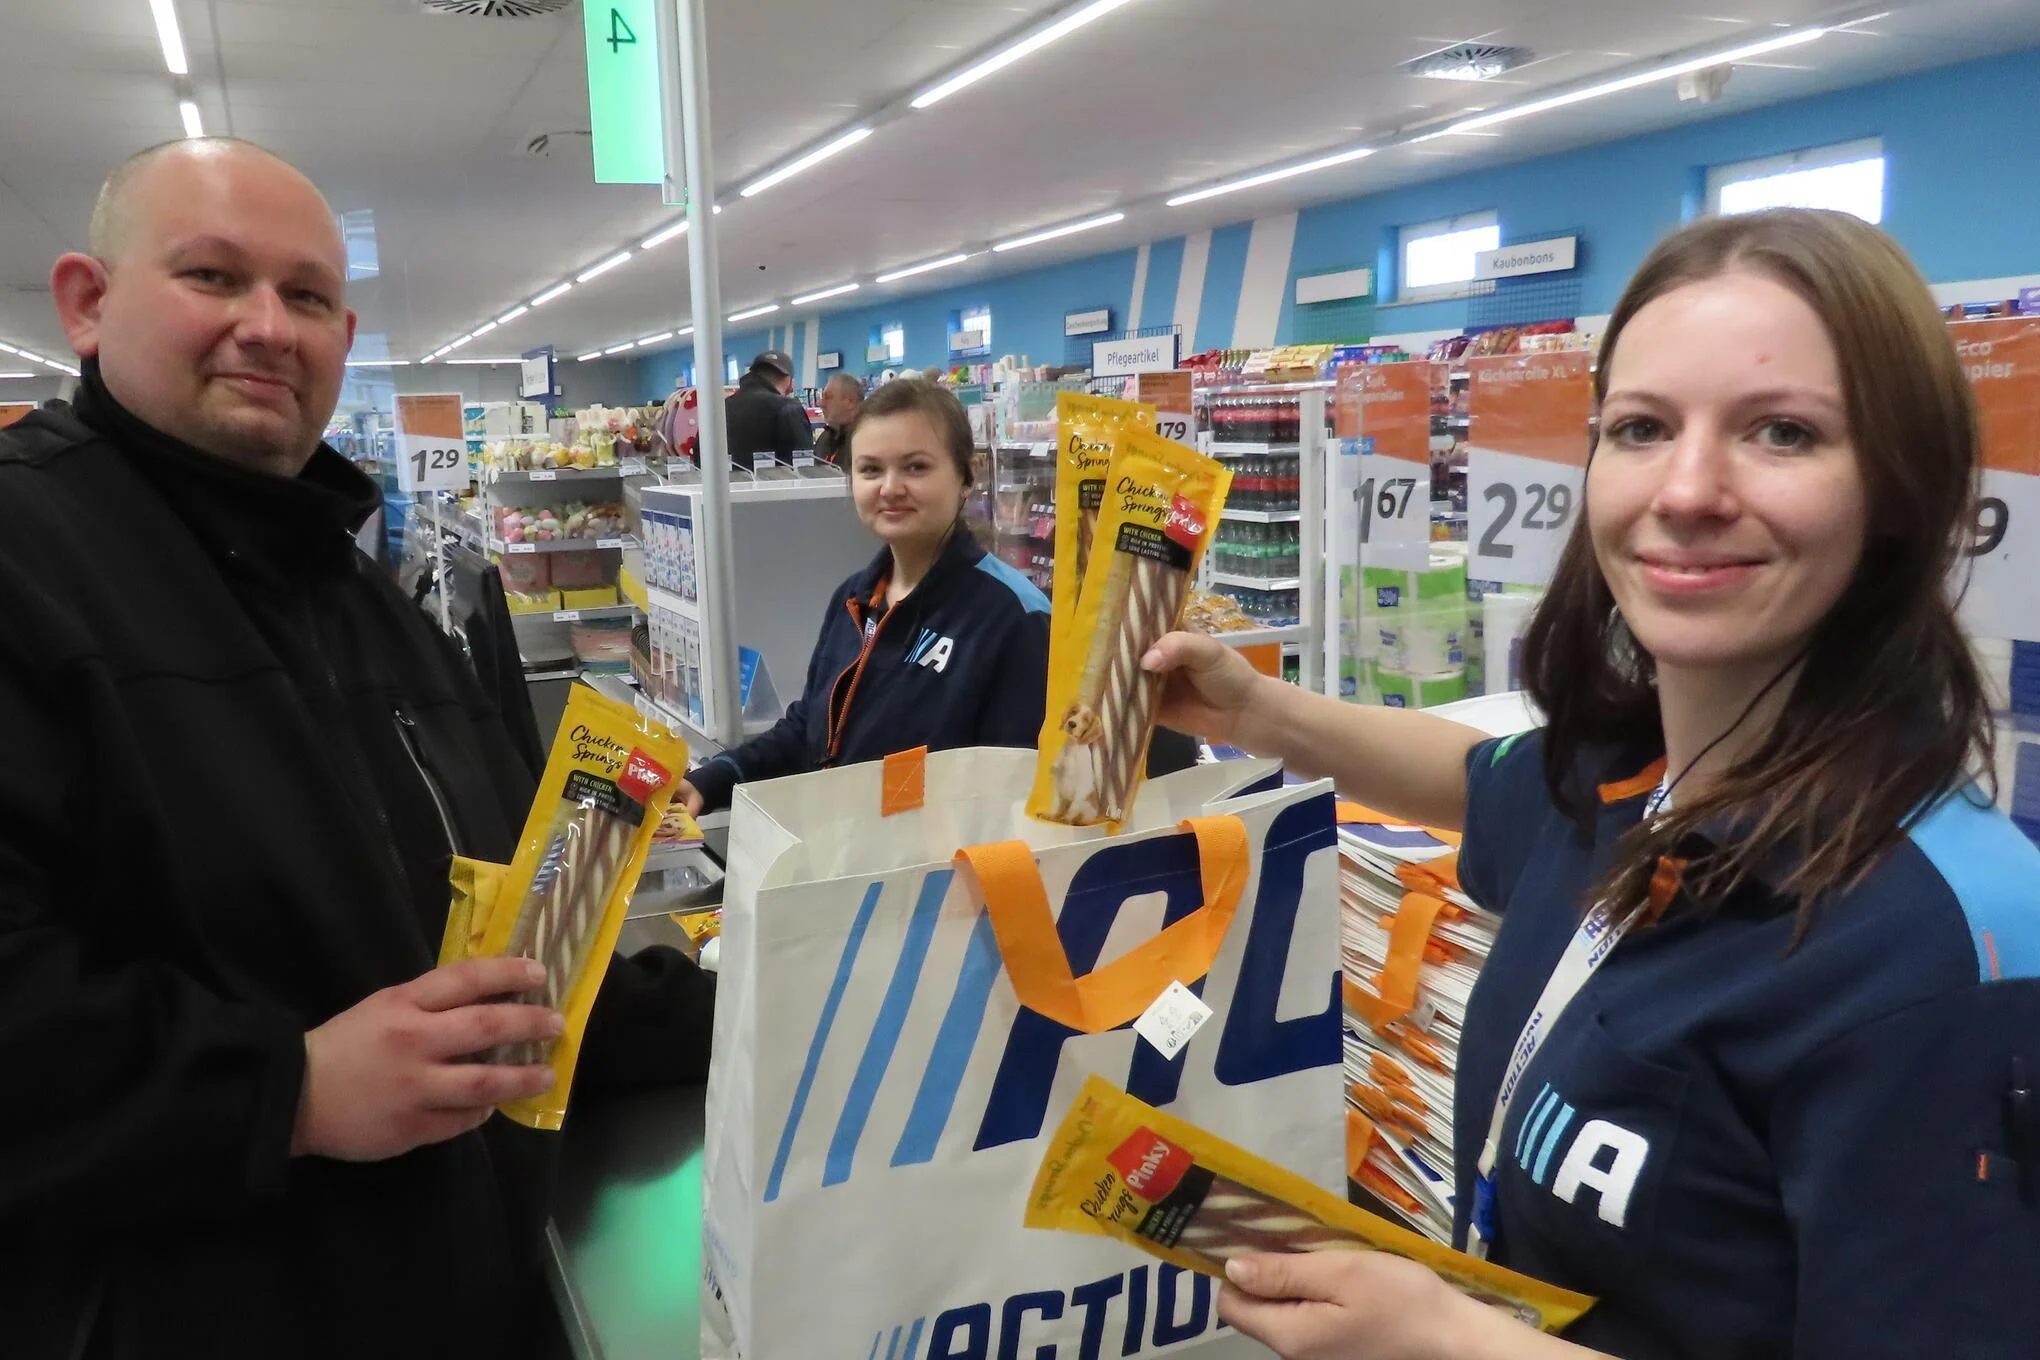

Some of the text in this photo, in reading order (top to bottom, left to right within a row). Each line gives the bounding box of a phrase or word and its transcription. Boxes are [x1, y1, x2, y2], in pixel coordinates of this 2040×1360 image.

[1492, 253, 1555, 270] Kaubonbons
[1107, 348, 1160, 367] Pflegeartikel
[1956, 337, 1992, 356] Eco
[1477, 482, 1571, 559] 229
[1501, 1035, 1537, 1107] ACTION
[1126, 1139, 1171, 1190] Pinky
[1552, 1119, 1649, 1228] A
[925, 1261, 1242, 1360] ACTIO
